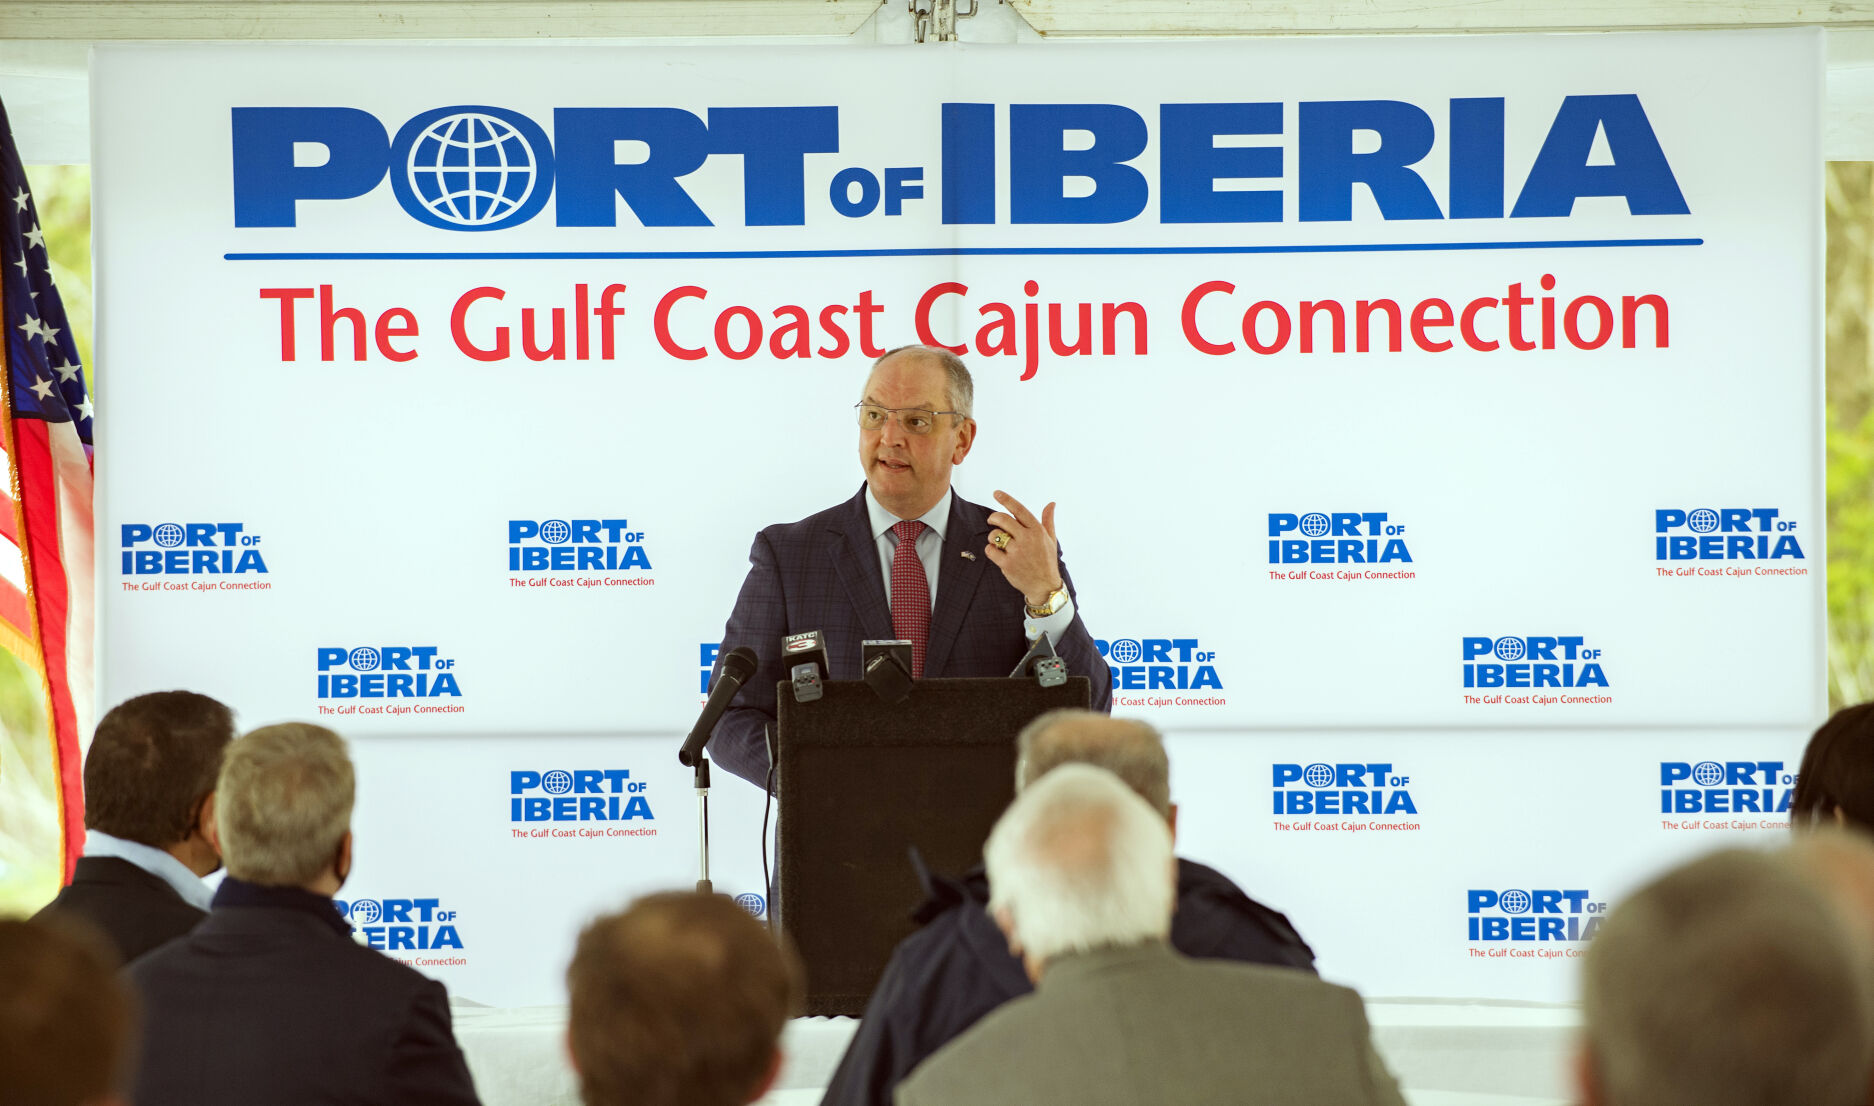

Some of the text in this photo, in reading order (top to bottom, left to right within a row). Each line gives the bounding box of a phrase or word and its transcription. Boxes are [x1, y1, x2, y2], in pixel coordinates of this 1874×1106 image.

[231, 94, 1692, 232] PORT OF IBERIA
[259, 273, 1671, 383] The Gulf Coast Cajun Connection
[509, 519, 645, 544] PORT OF
[1268, 512, 1405, 537] PORT OF
[1656, 508, 1797, 533] PORT OF
[122, 523, 261, 548] PORT OF
[1656, 535, 1804, 560] IBERIA
[122, 550, 268, 574] IBERIA
[509, 546, 652, 571] IBERIA
[1269, 539, 1413, 564] IBERIA
[509, 576, 655, 589] The Gulf Coast Cajun Connection
[1269, 569, 1416, 582] The Gulf Coast Cajun Connection
[1657, 566, 1808, 577] The Gulf Coast Cajun Connection
[121, 581, 272, 593] The Gulf Coast Cajun Connection
[787, 631, 816, 642] KATC
[1463, 636, 1601, 661] PORT OF
[318, 646, 455, 671] PORT OF
[1196, 652, 1215, 662] OF
[318, 673, 462, 698] IBERIA
[1112, 665, 1224, 690] ERIA
[1464, 663, 1609, 688] IBERIA
[318, 703, 465, 717] The Gulf Coast Cajun Connection
[1120, 696, 1145, 706] Coast
[1147, 697, 1173, 707] Cajun
[1175, 696, 1226, 706] Connection
[1463, 694, 1613, 707] The Gulf Coast Cajun Connection
[511, 769, 647, 795] PORT OF
[1272, 763, 1410, 788] PORT OF
[1661, 761, 1783, 786] PORT
[511, 796, 654, 822] IBERIA
[1272, 790, 1418, 815] IBERIA
[511, 827, 657, 839] The Gulf Coast Cajun Connection
[1273, 821, 1421, 833] The Gulf Coast Cajun Connection
[1661, 819, 1792, 830] The Gulf Coast Cajun Conne
[1468, 889, 1607, 914] PORT OF
[437, 911, 456, 921] OF
[350, 925, 464, 950] ERIA
[415, 957, 466, 967] Connection
[1468, 947, 1486, 958] The
[1487, 947, 1507, 958] Gulf
[1509, 948, 1535, 958] Coast
[1537, 949, 1563, 961] Cajun
